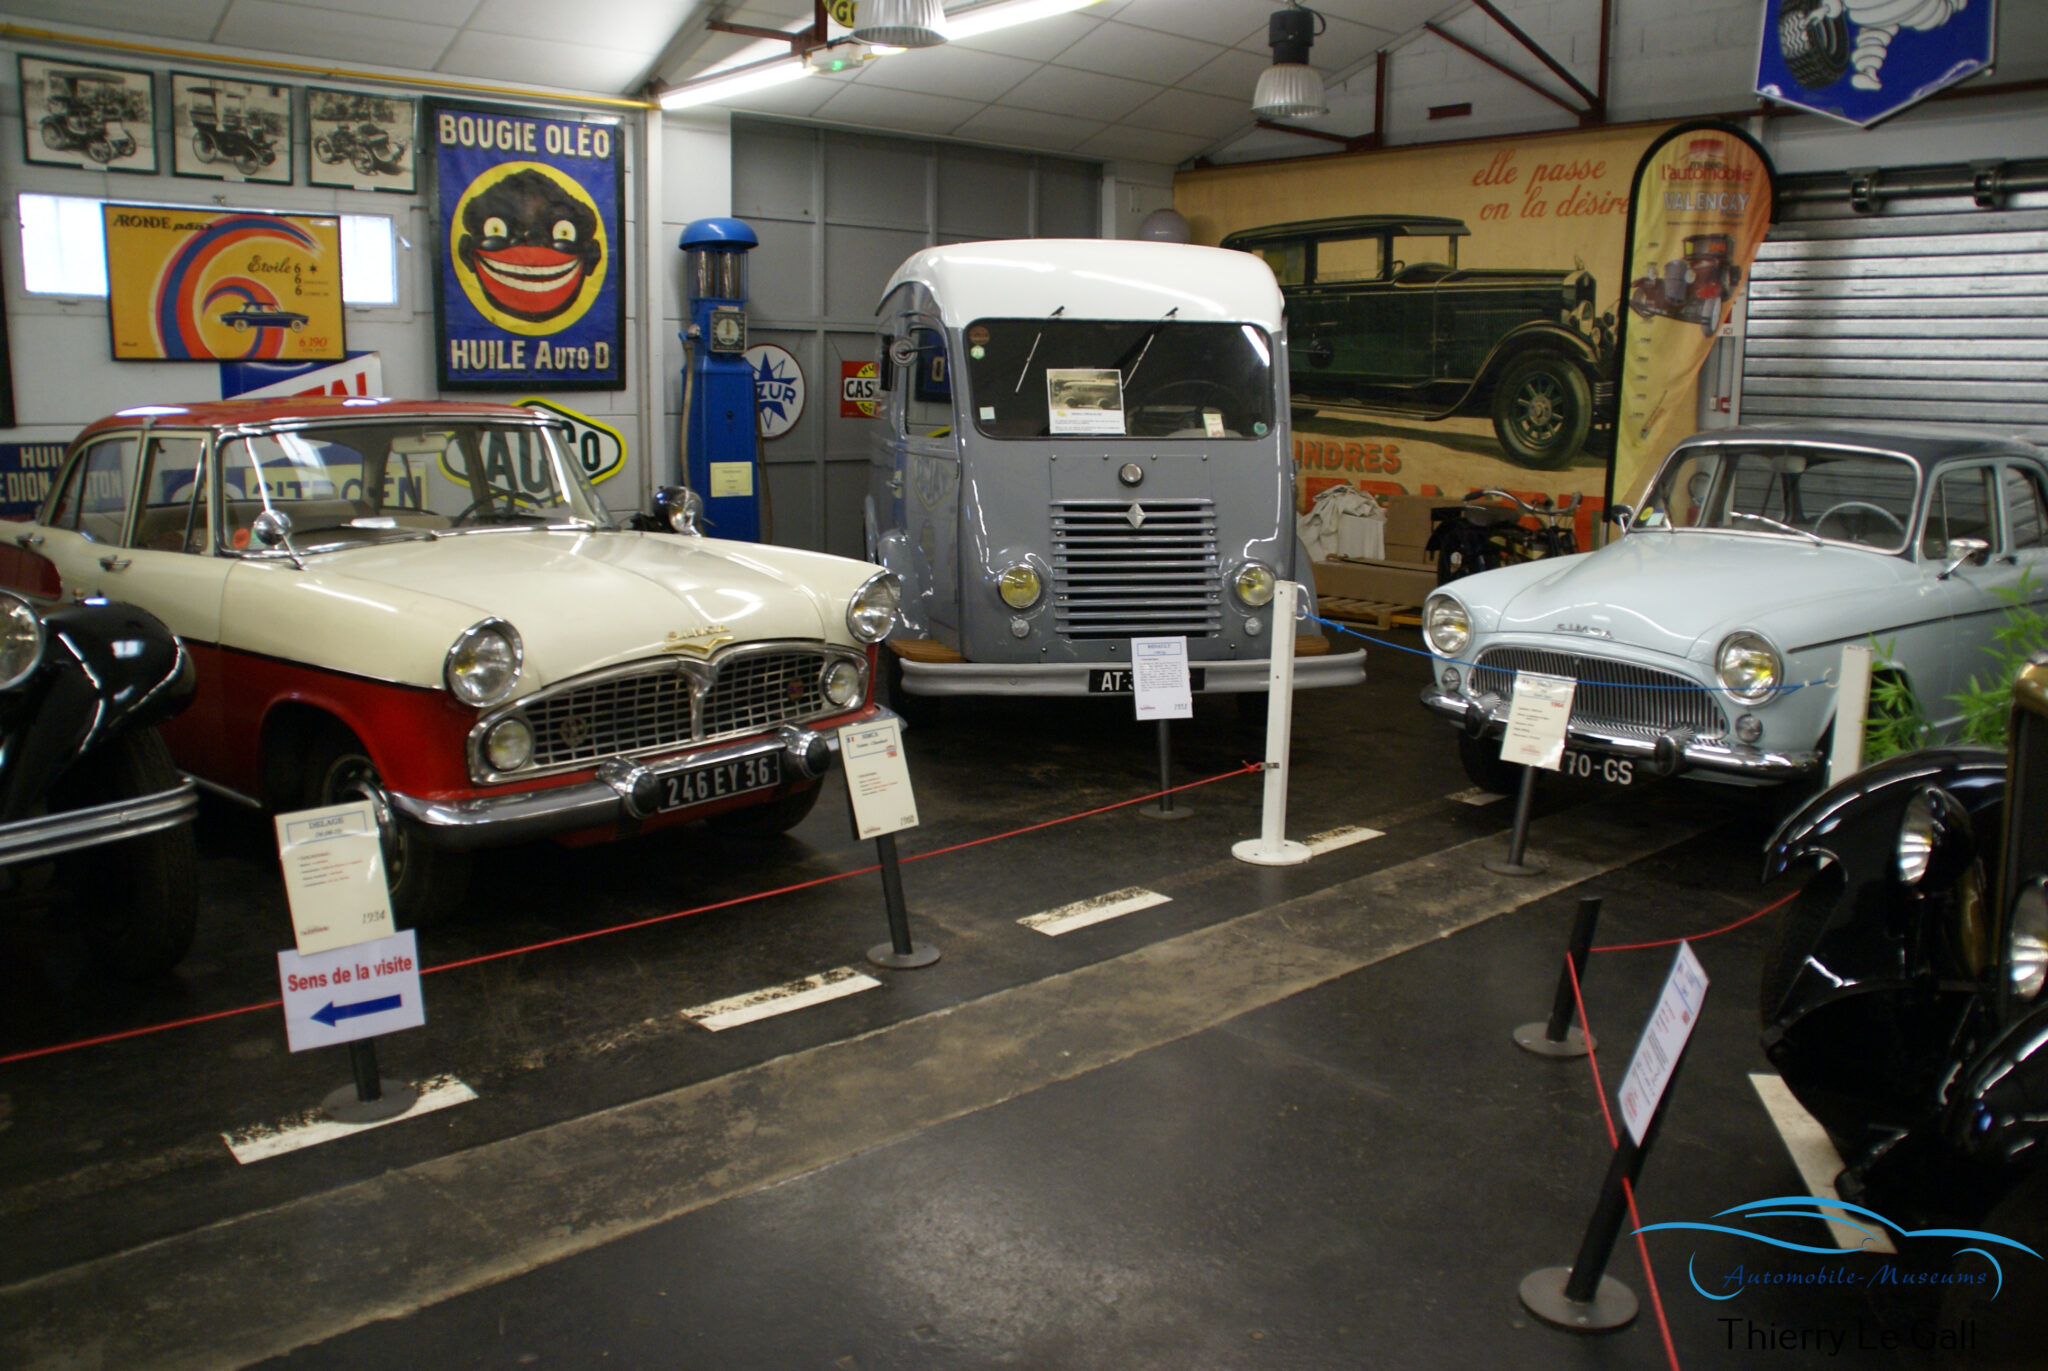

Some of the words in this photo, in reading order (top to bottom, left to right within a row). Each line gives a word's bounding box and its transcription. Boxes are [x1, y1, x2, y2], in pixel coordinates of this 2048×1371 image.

[438, 114, 538, 153] BOUGIE
[544, 124, 611, 159] OLÉO
[1472, 150, 1518, 187] elle
[1525, 159, 1607, 194] passe
[1661, 163, 1753, 181] l'automobile
[1479, 202, 1511, 221] on
[1520, 186, 1548, 219] la
[451, 339, 526, 370] HUILE
[594, 341, 610, 370] D
[757, 382, 796, 405] ZUR
[846, 380, 873, 398] CAS
[1294, 440, 1402, 475] INDRES
[667, 771, 709, 807] 246
[714, 763, 739, 795] EY
[745, 757, 770, 788] 36
[287, 973, 328, 992] Sens
[332, 967, 352, 985] de
[355, 963, 370, 981] la
[374, 956, 413, 977] visite
